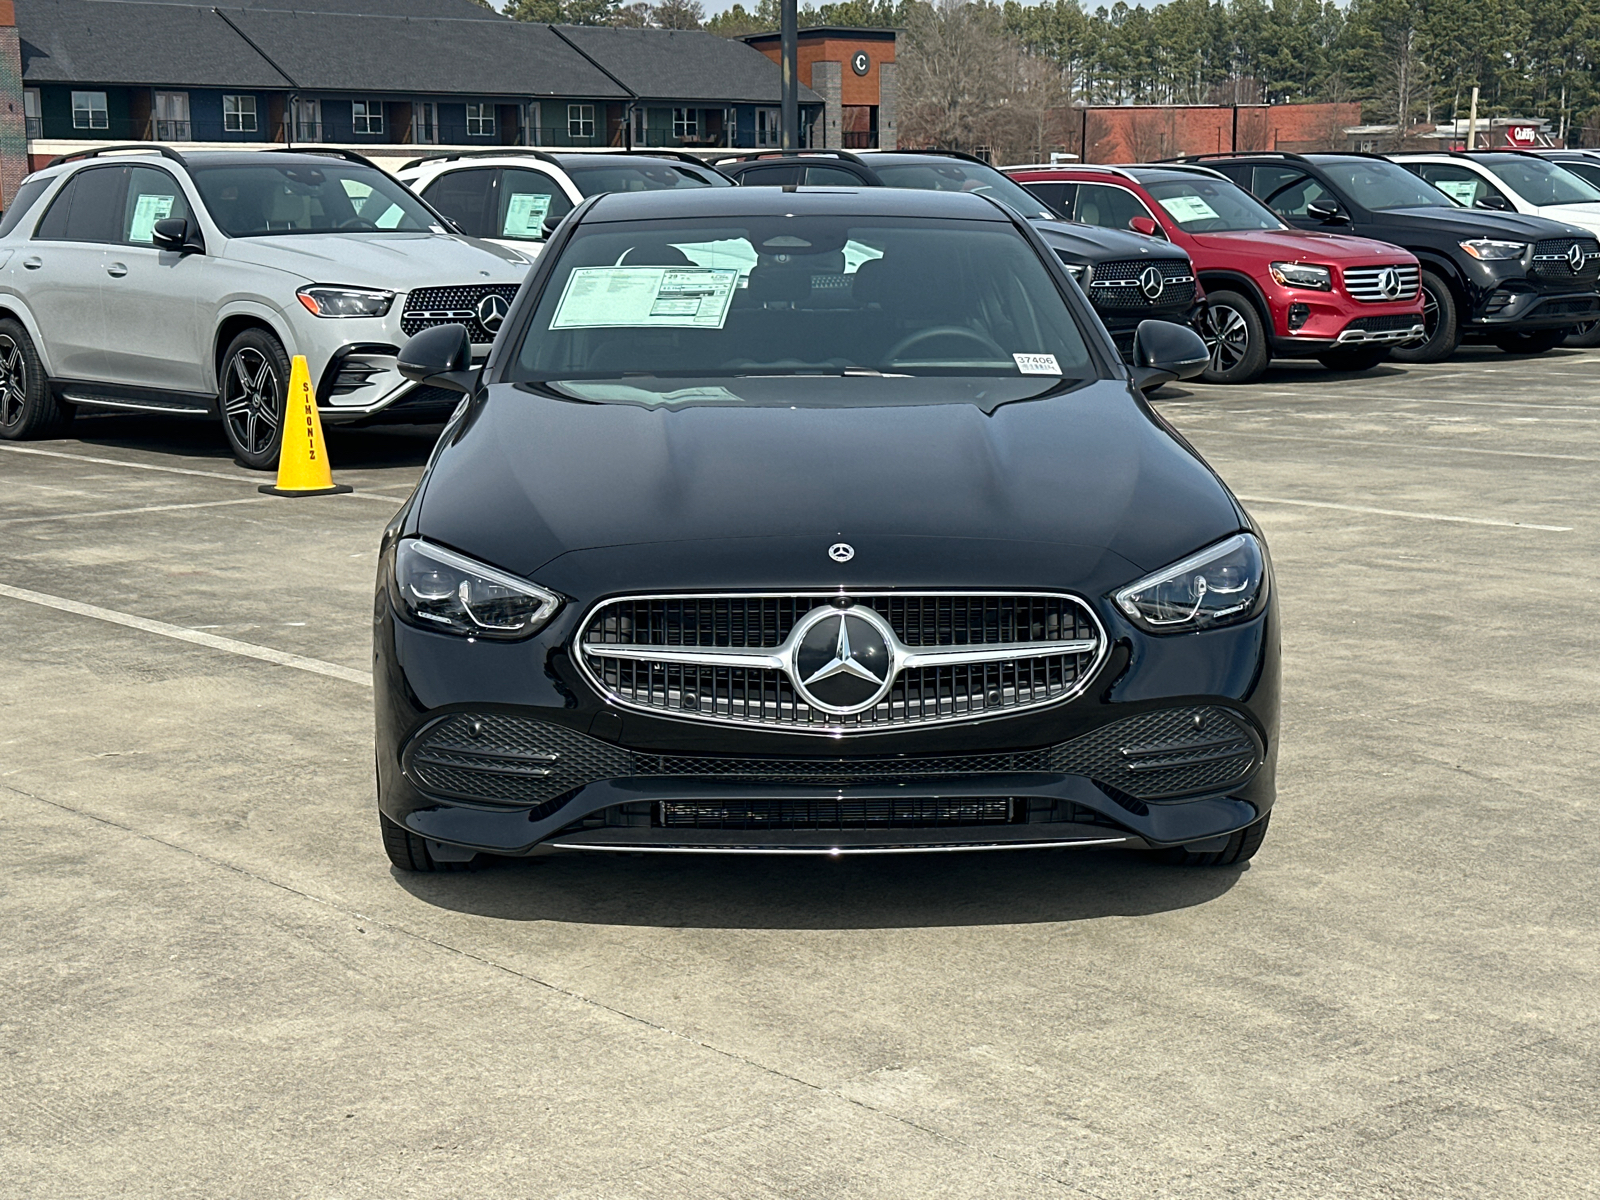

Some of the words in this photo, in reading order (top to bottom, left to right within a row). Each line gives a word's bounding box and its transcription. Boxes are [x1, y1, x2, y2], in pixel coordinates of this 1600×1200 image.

[856, 55, 866, 70] C
[1017, 356, 1053, 364] 37406
[303, 382, 316, 460] SIMONIZ
